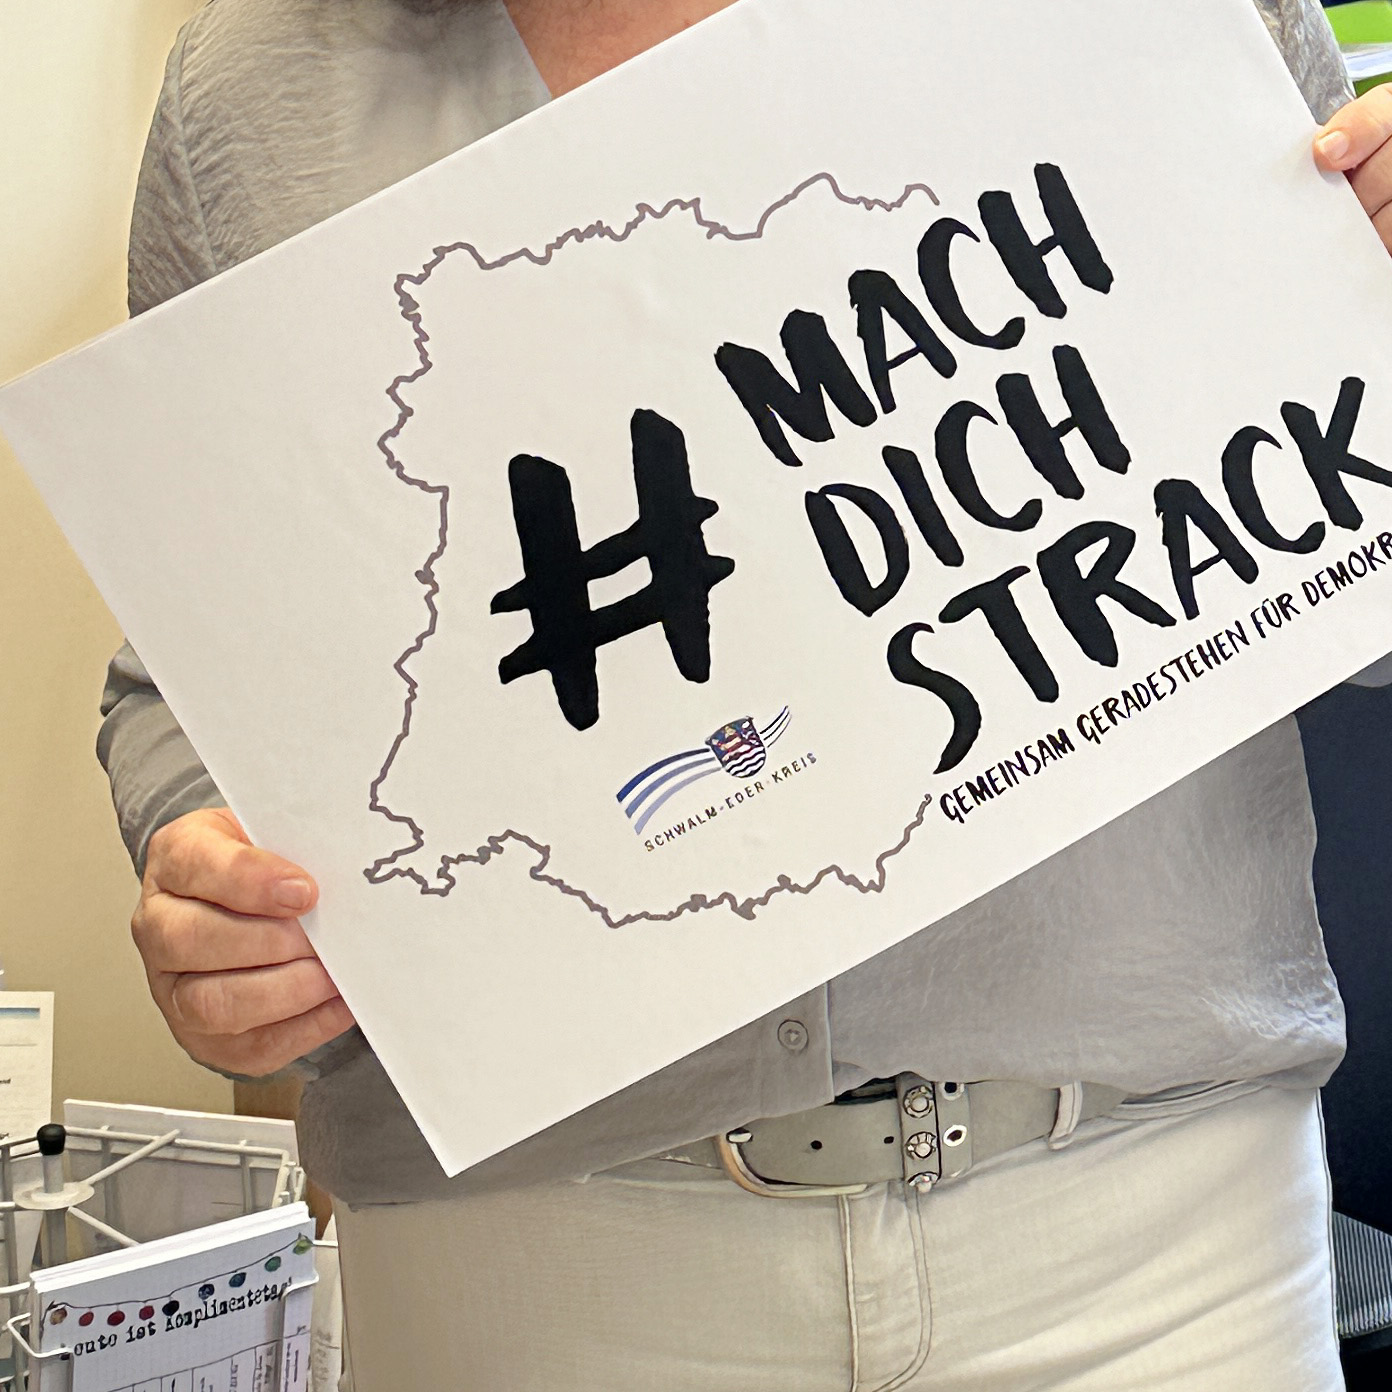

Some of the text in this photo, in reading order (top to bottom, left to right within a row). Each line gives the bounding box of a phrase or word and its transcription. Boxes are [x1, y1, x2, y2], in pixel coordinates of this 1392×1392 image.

[714, 163, 1113, 467] MACH
[805, 345, 1131, 617] DICH
[940, 729, 1075, 823] GEMEINSAM
[1077, 621, 1249, 744] GERADESTEHEN
[1251, 594, 1300, 638] FÜR
